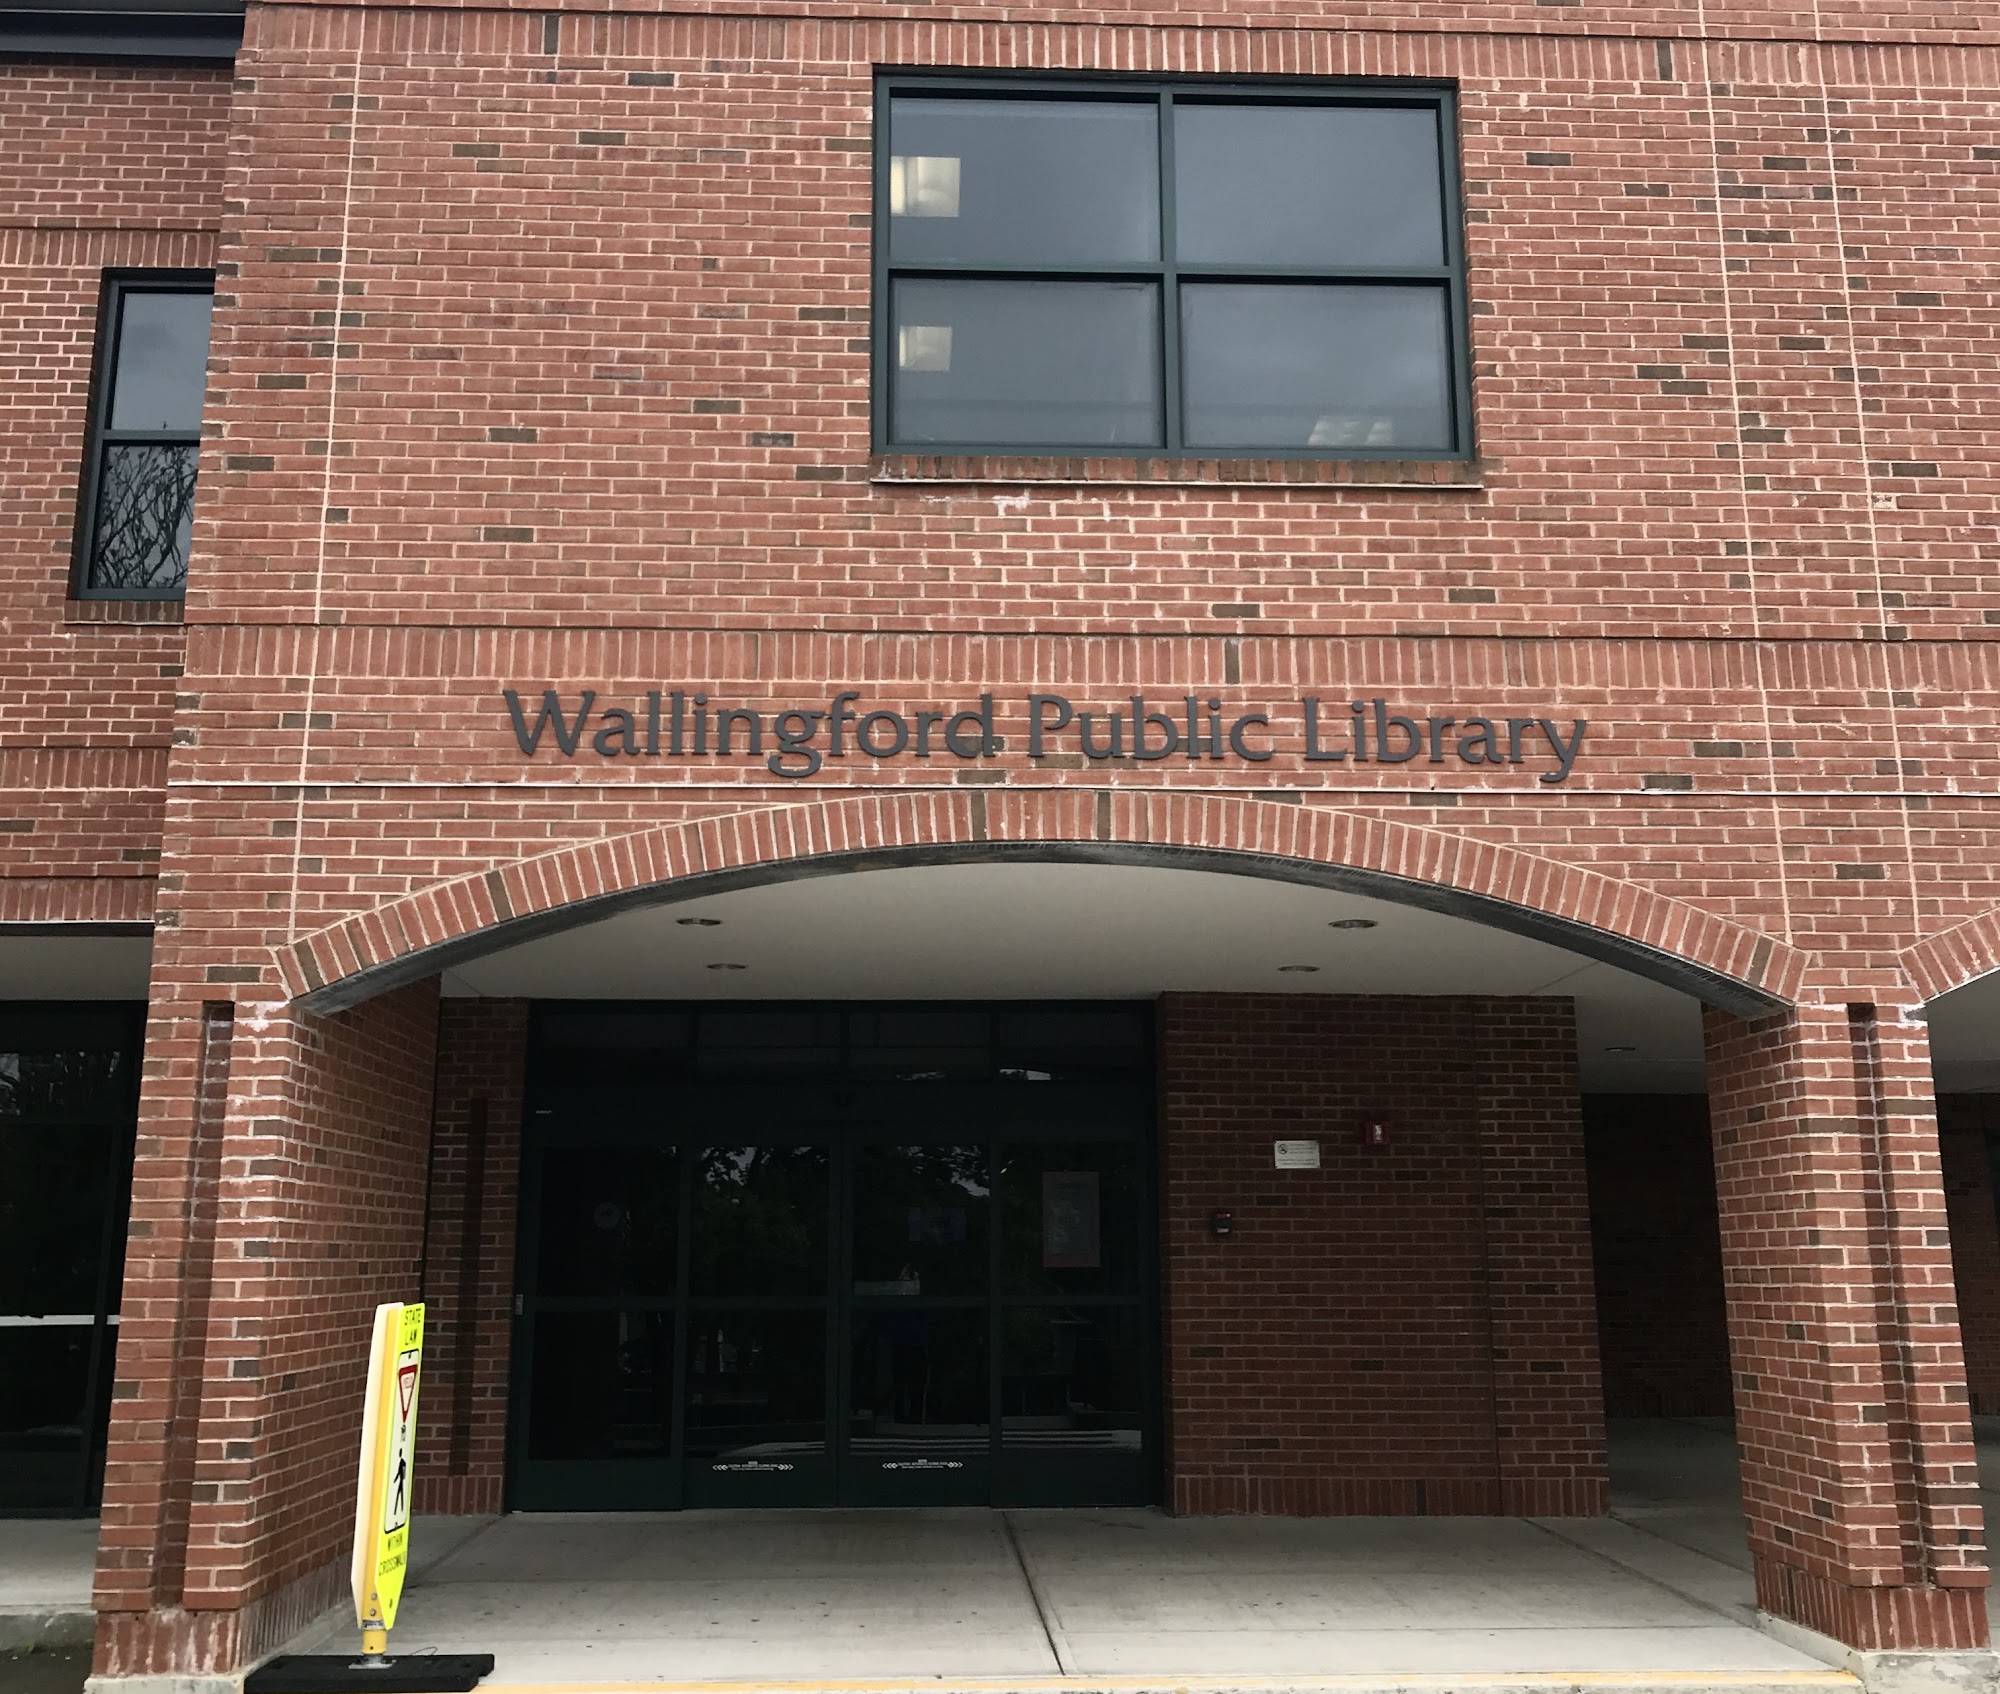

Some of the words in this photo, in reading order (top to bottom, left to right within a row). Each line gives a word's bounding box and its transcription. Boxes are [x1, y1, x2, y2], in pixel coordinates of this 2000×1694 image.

[502, 689, 996, 778] Wallingford
[1027, 693, 1276, 761] Public
[1302, 696, 1586, 784] Library
[404, 1307, 422, 1326] STATE
[404, 1328, 418, 1346] LAW
